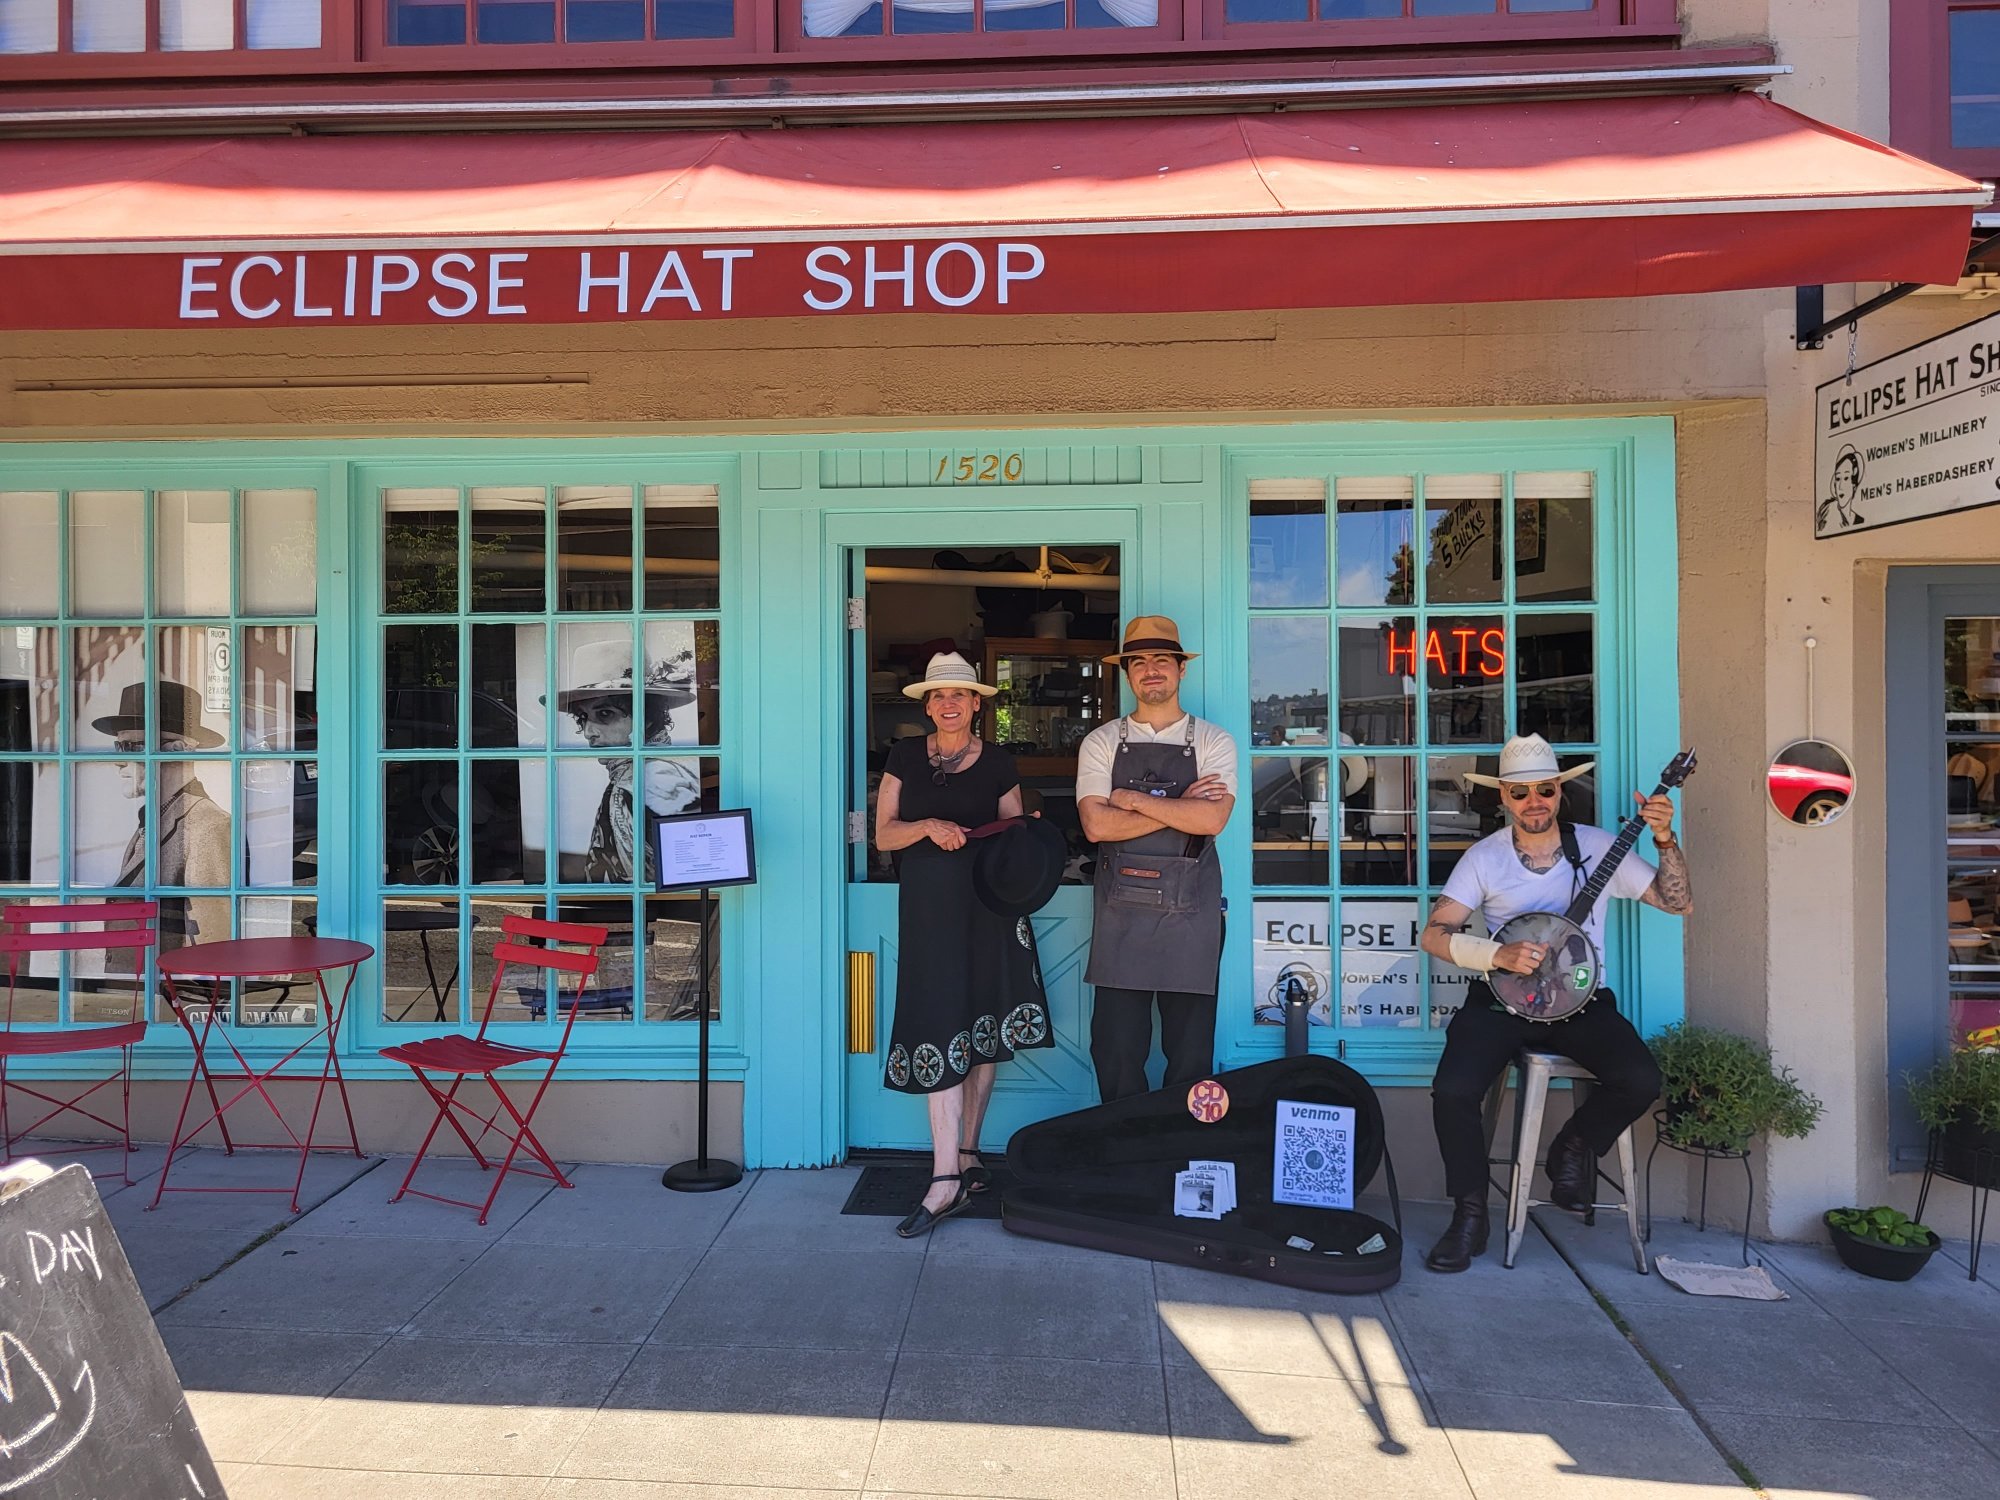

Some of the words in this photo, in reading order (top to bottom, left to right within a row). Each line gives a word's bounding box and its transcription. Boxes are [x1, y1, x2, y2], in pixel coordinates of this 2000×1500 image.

[178, 253, 529, 320] ECLIPSE
[577, 248, 754, 314] HAT
[802, 241, 1047, 312] SHOP
[1829, 377, 1906, 430] ECLIPSE
[1915, 357, 1959, 399] HAT
[1866, 438, 1915, 462] WOMEN'S
[1919, 416, 1987, 448] MILLINERY
[935, 453, 1023, 482] 1520
[1860, 484, 1892, 501] MEN'S
[1896, 457, 1995, 493] HABERDASHERY
[1441, 543, 1453, 569] 5
[1452, 510, 1486, 555] BUCKS
[1388, 629, 1506, 676] HATS
[1342, 972, 1408, 985] OMEN'S
[1192, 1100, 1223, 1122] $10
[1194, 1081, 1225, 1102] CD
[1291, 1106, 1341, 1122] venmo
[26, 1226, 103, 1285] DAY
